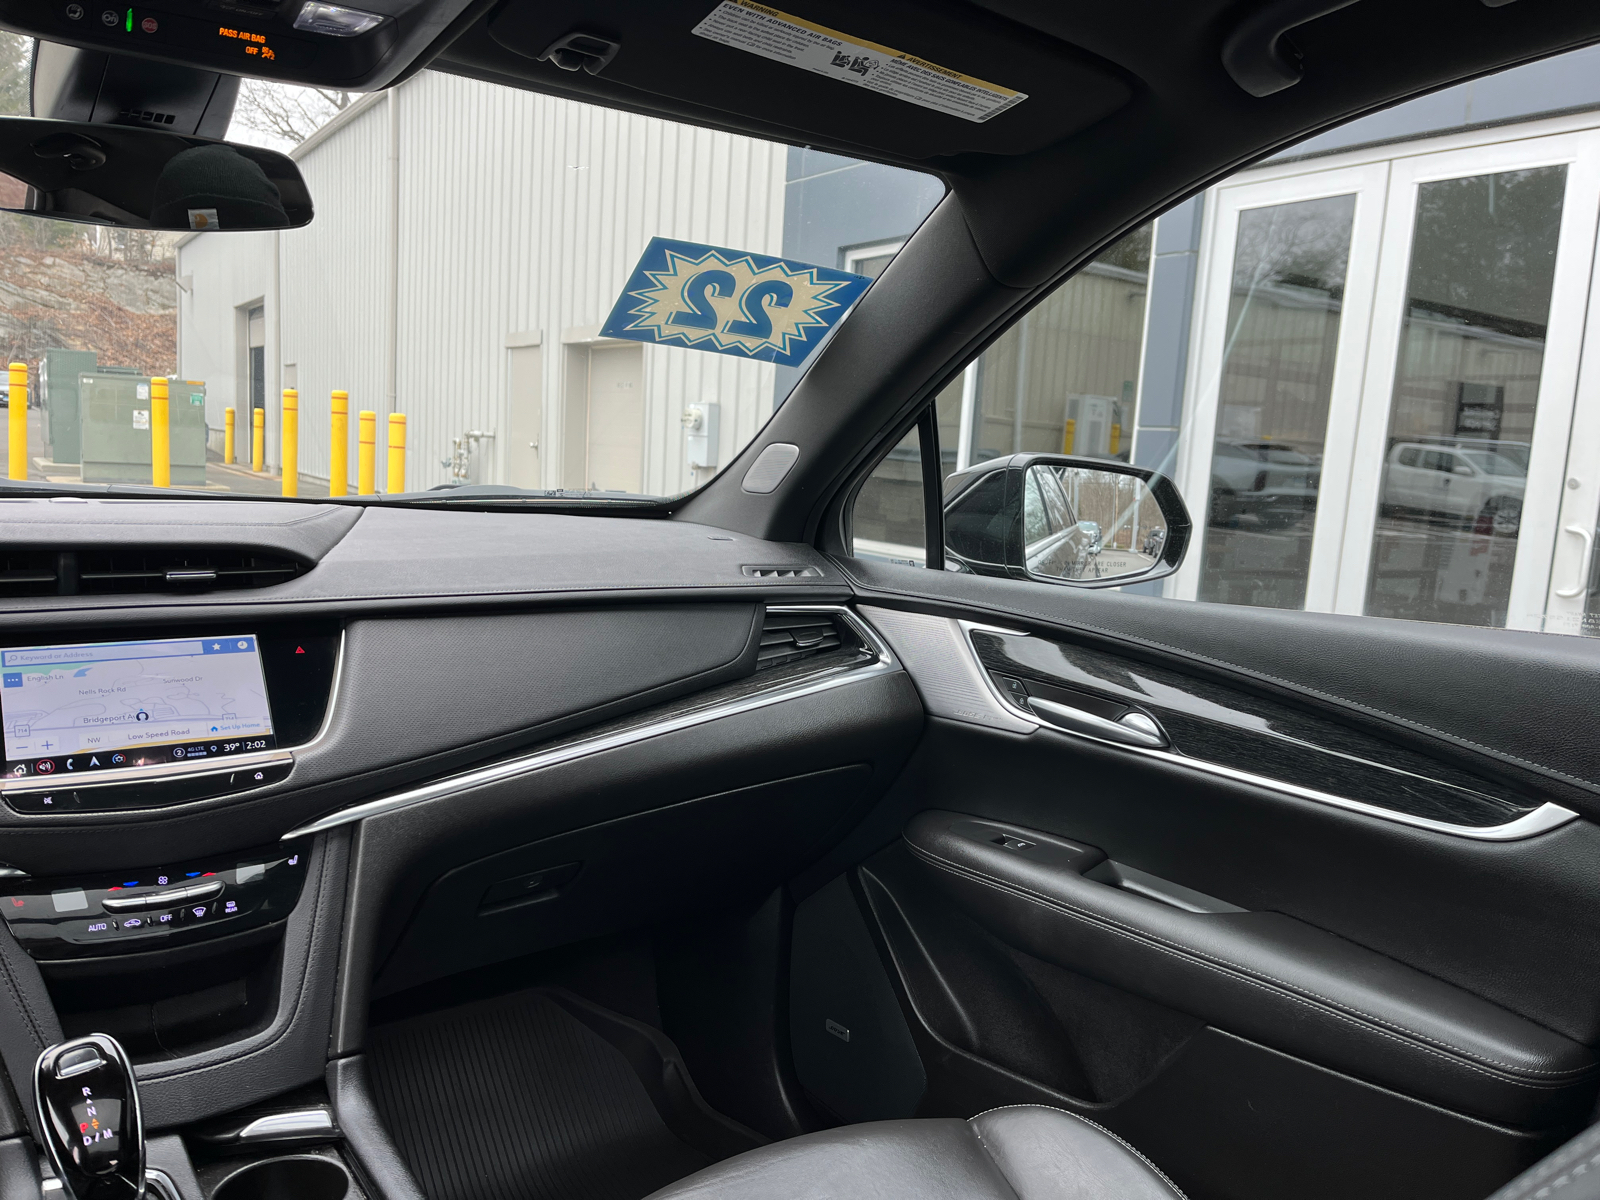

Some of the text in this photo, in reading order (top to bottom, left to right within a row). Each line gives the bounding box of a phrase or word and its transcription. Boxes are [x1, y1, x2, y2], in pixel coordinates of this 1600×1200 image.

[740, 0, 779, 17] WARNING
[143, 21, 156, 29] SOS
[722, 3, 744, 13] EVEN
[744, 11, 767, 20] WITH
[765, 18, 808, 34] ADVANCED
[821, 37, 842, 46] BAGS
[219, 27, 266, 44] PASS AIR BAG
[245, 46, 259, 55] OFF
[905, 64, 923, 72] AVEC
[908, 56, 963, 79] AVERTISSEMENT
[20, 654, 52, 662] Keyword
[27, 675, 54, 683] English
[163, 676, 194, 684] Sunwood
[83, 714, 126, 724] Bridgeport
[145, 730, 169, 740] Speed
[171, 728, 190, 736] Road
[223, 742, 240, 752] 39°
[246, 740, 266, 750] 2:02
[160, 914, 173, 922] OFF
[88, 923, 107, 932] AUTO
[82, 1086, 92, 1097] R
[87, 1106, 97, 1117] N
[80, 1122, 89, 1134] P
